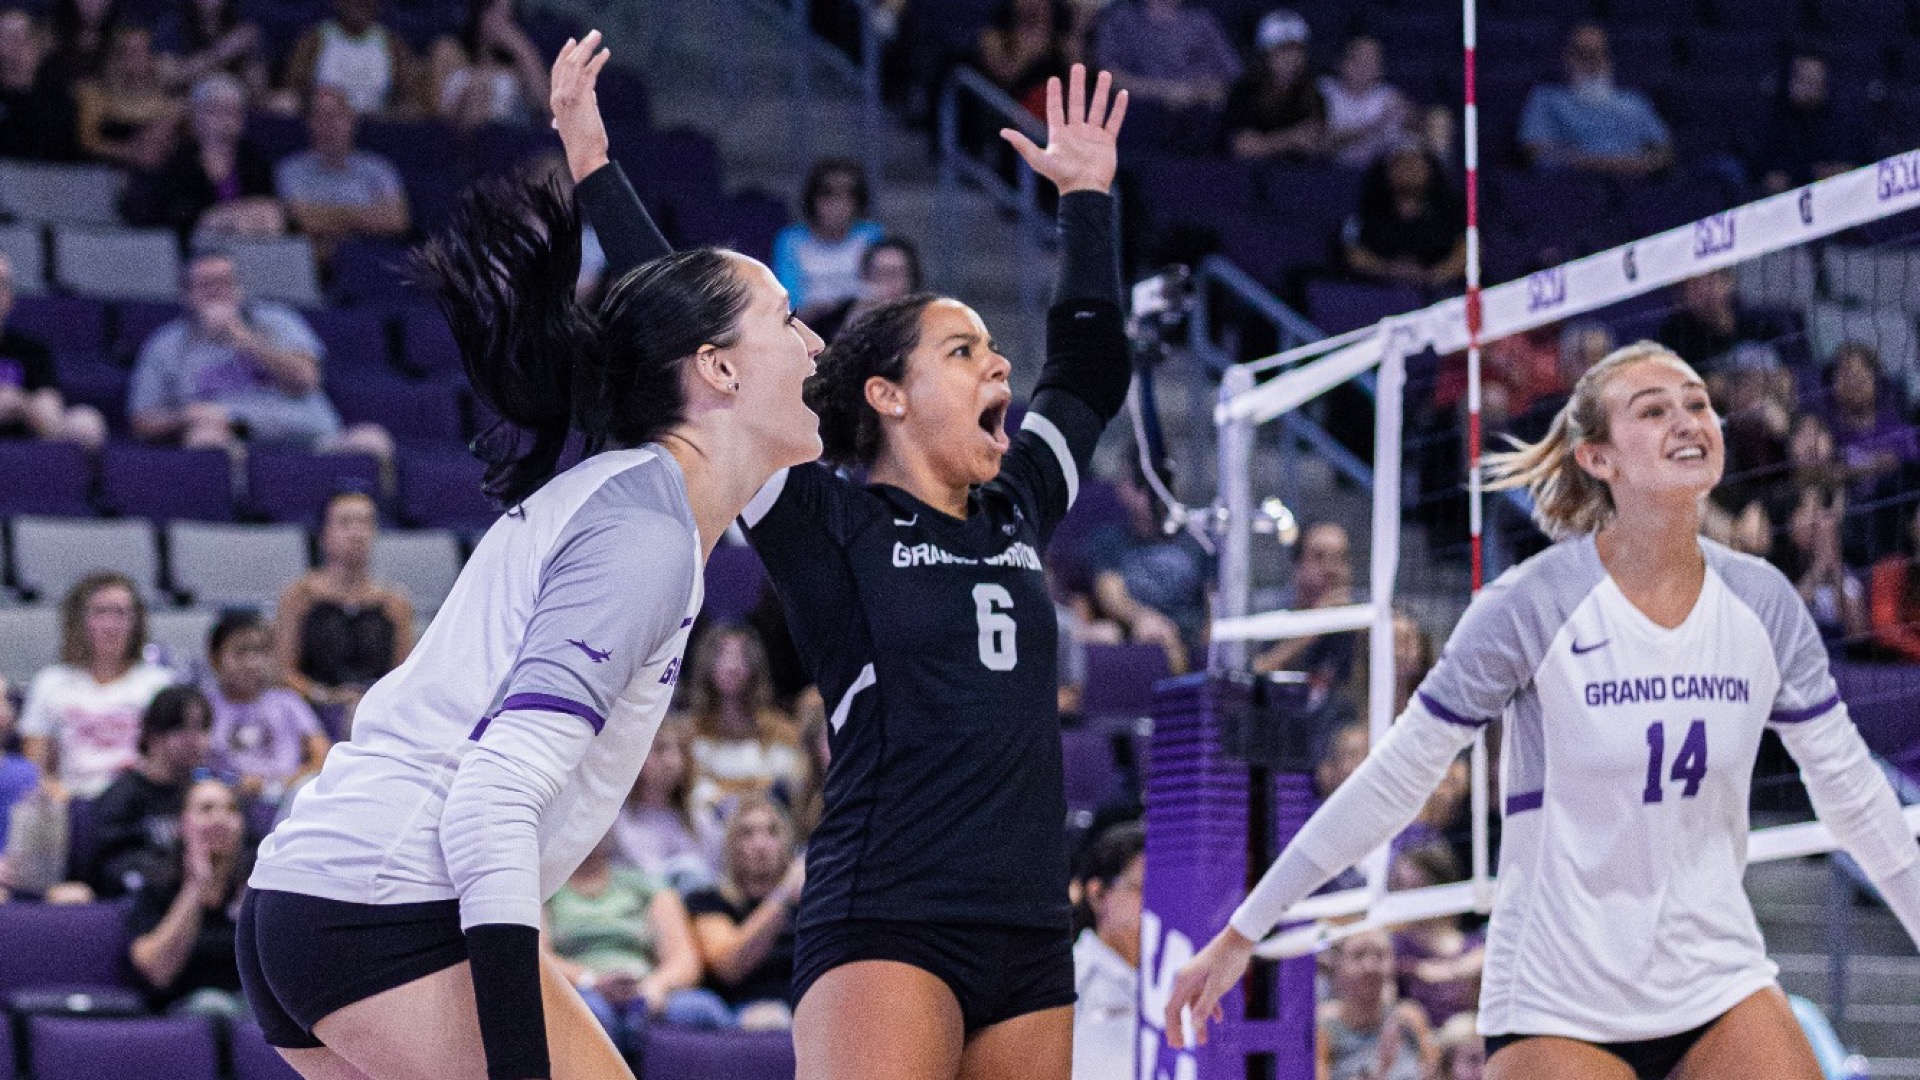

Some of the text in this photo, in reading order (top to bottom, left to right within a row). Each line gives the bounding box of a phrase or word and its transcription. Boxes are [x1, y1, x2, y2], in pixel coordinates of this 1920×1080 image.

[972, 583, 1018, 671] 6
[1585, 674, 1750, 707] GRAND CANYON
[1642, 719, 1708, 805] 14
